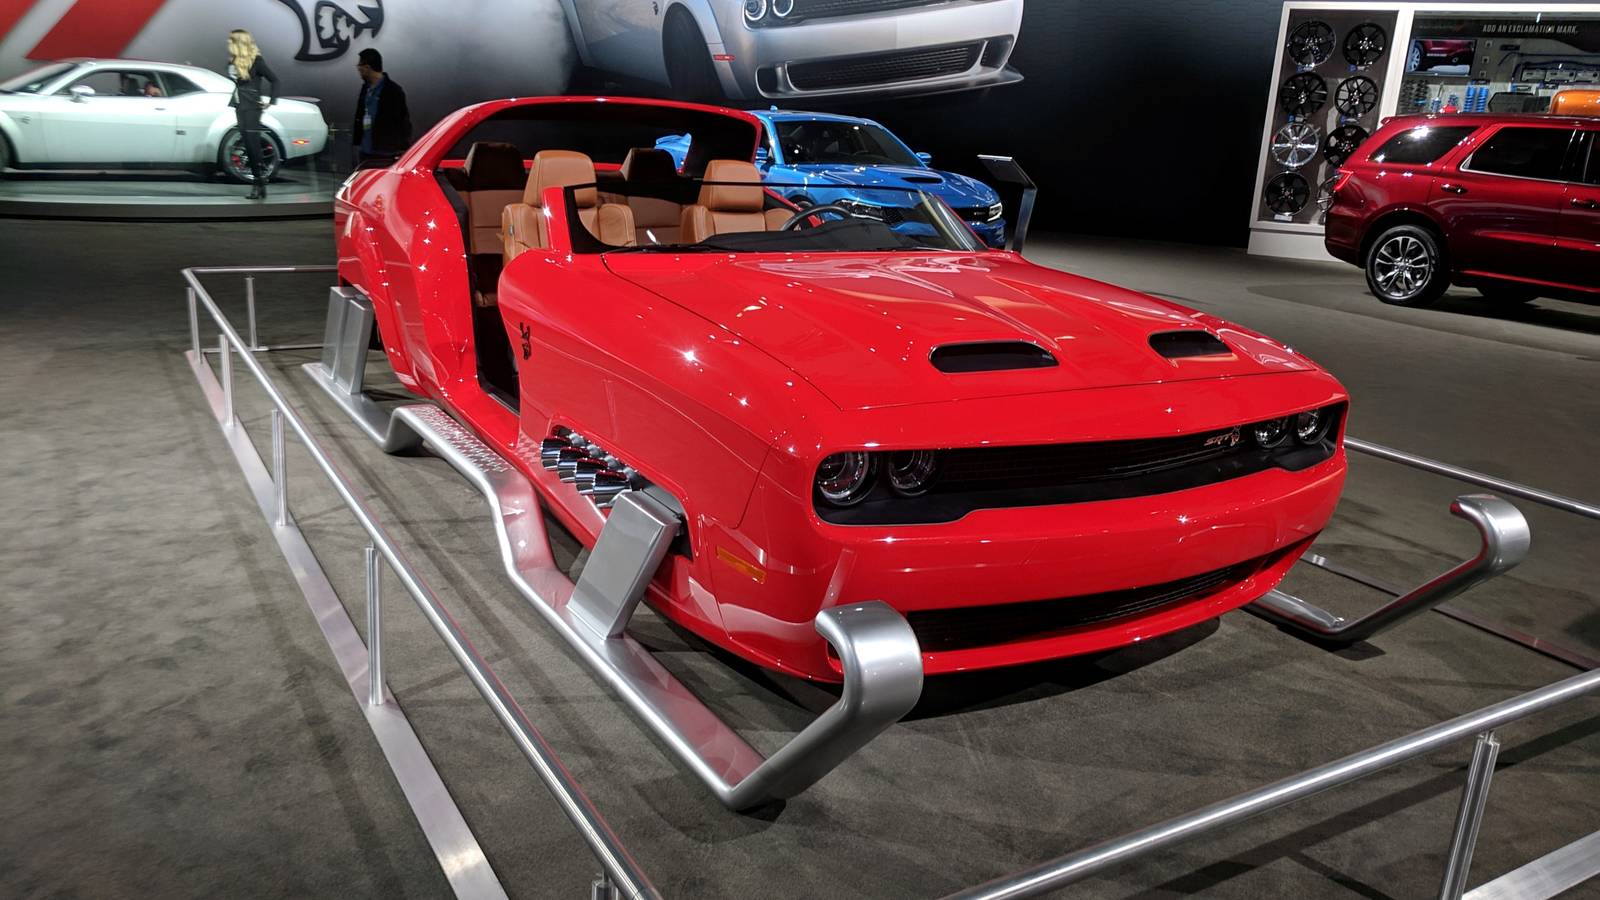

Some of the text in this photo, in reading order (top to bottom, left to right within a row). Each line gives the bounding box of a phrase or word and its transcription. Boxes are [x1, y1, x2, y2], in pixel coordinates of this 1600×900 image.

[1482, 24, 1496, 33] ADD
[1497, 24, 1507, 33] AN
[1508, 24, 1555, 33] EXCLAMATION
[1203, 432, 1232, 447] SRT
